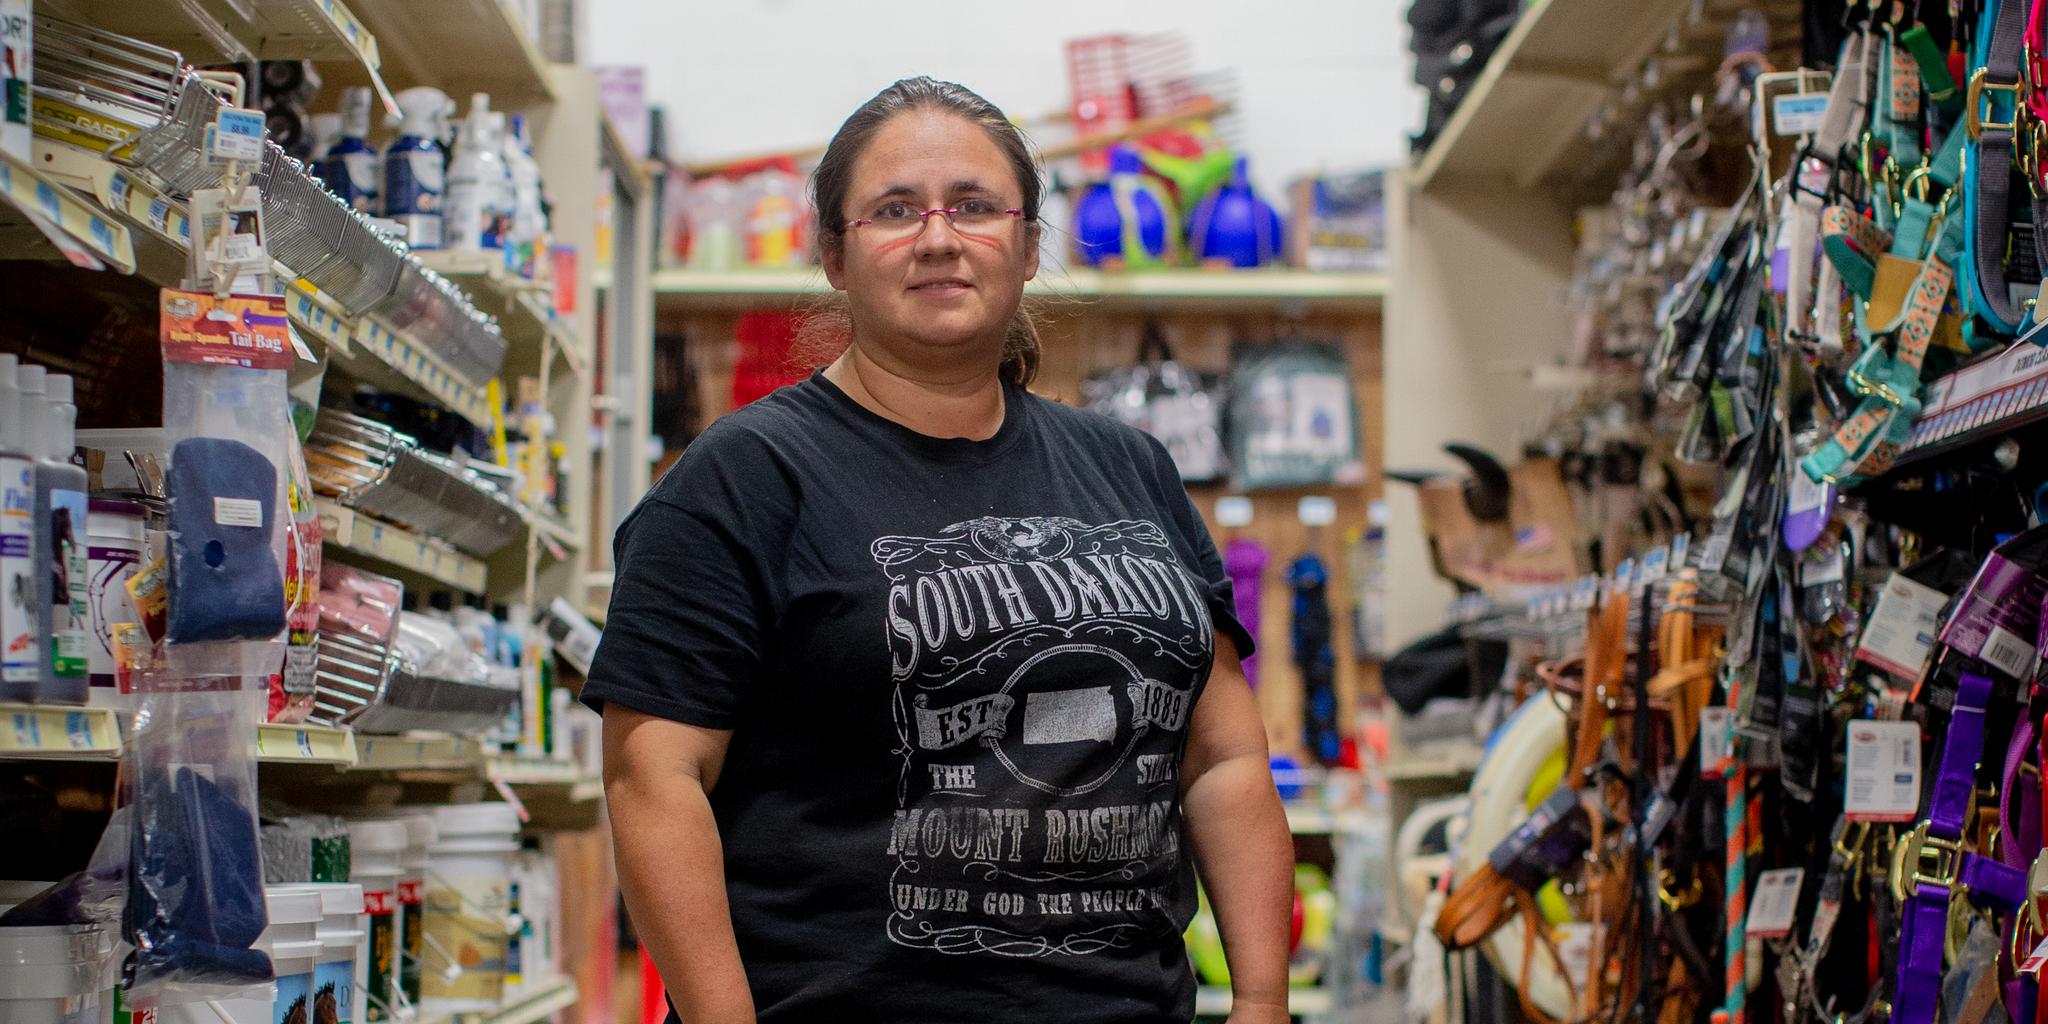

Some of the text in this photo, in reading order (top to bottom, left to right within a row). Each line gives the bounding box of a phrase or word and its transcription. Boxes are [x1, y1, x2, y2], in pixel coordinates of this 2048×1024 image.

[229, 331, 253, 348] Tail
[256, 334, 283, 353] Bag
[887, 564, 1039, 682] SOUTH
[937, 684, 1182, 746] EST 1889
[928, 763, 976, 790] THE
[887, 807, 1030, 863] MOUNT
[896, 884, 969, 913] UNDER
[983, 893, 1025, 916] GOD
[1037, 892, 1072, 915] THE
[1081, 888, 1146, 913] PEOPLE
